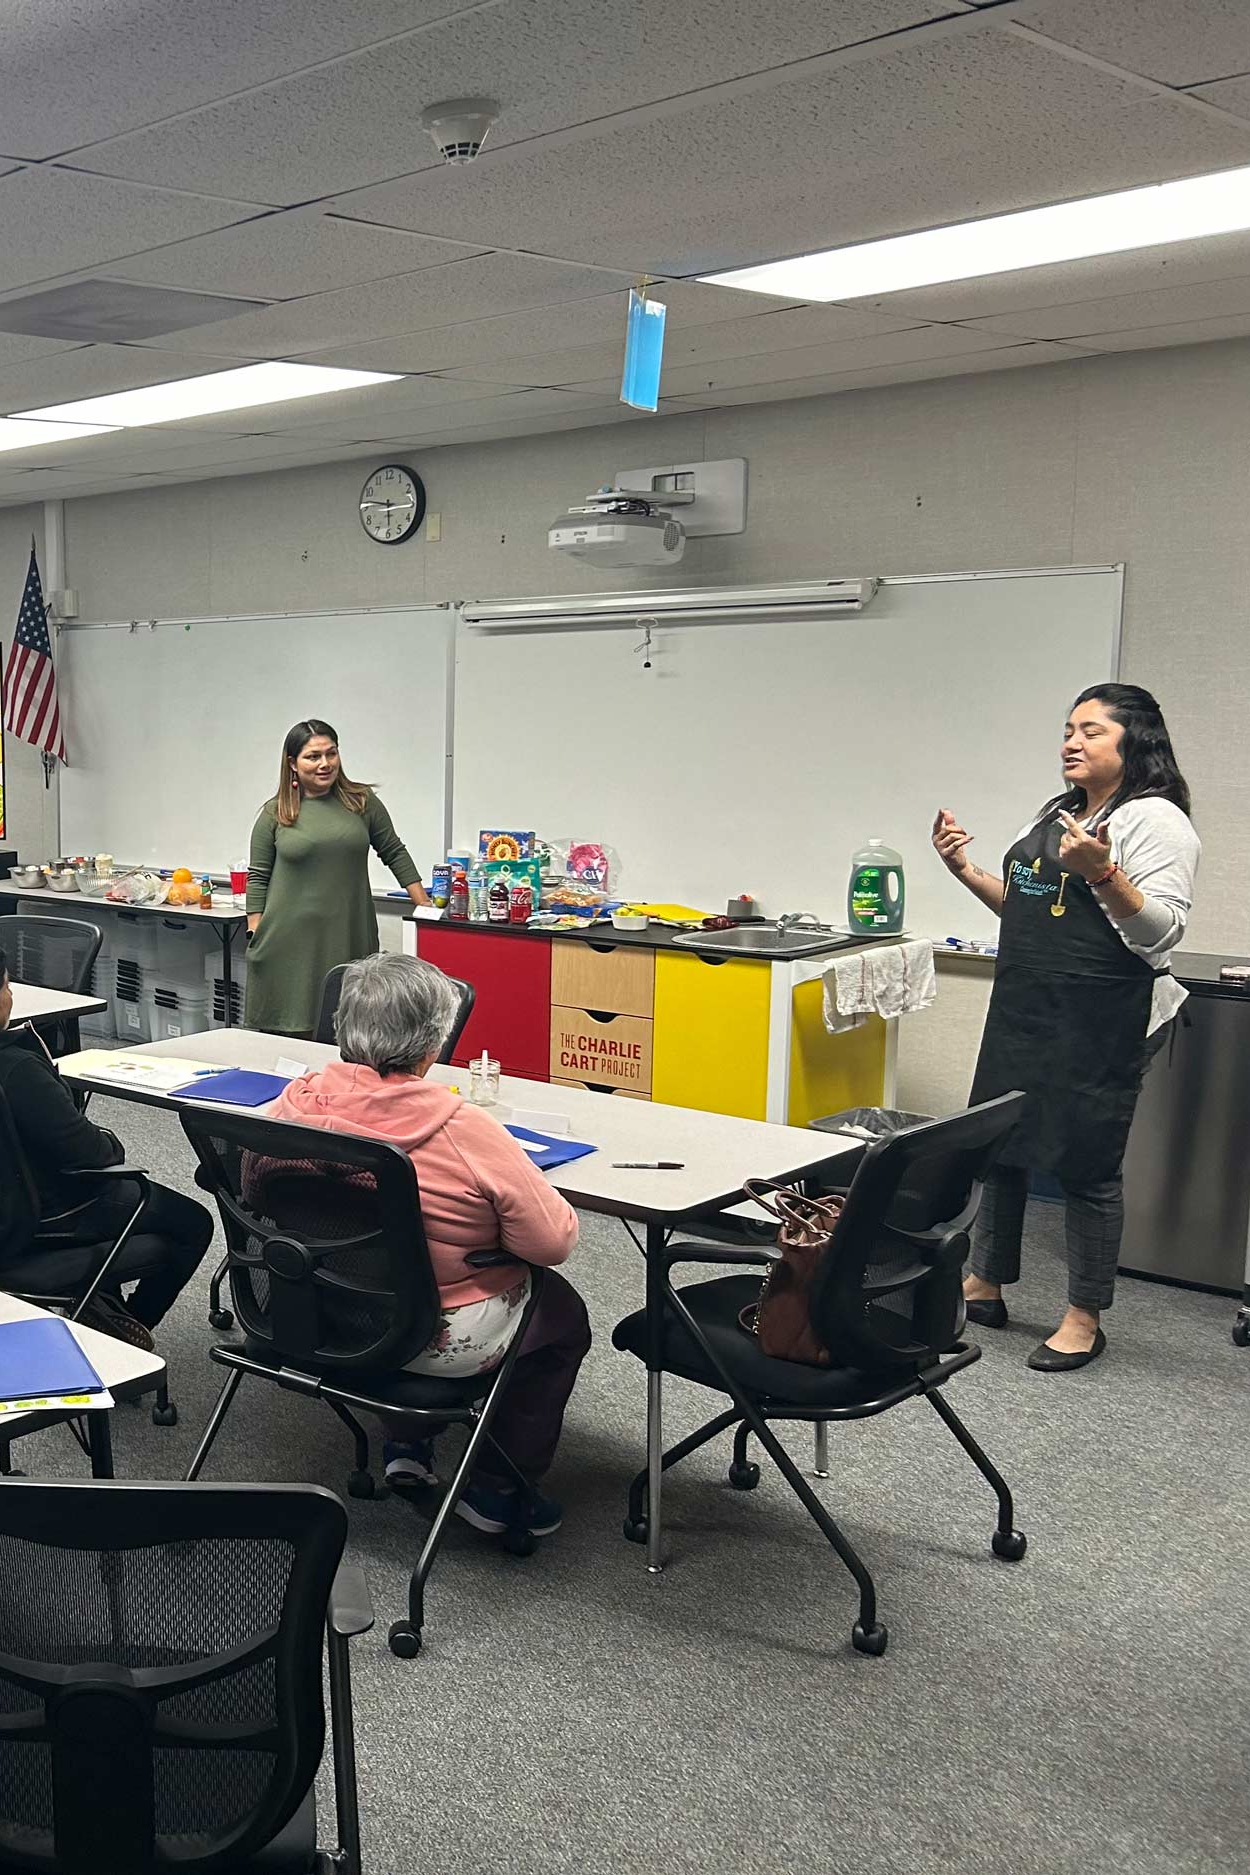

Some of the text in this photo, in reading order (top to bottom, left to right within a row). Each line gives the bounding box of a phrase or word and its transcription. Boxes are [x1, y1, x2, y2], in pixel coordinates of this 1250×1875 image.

[385, 470, 395, 480] 12
[375, 476, 382, 486] 11
[365, 486, 374, 497] 10
[406, 483, 412, 494] 2
[366, 515, 372, 525] 8
[406, 513, 411, 523] 4
[374, 526, 381, 536] 7
[385, 529, 391, 539] 6
[396, 524, 402, 534] 5
[1013, 860, 1023, 874] Yo
[560, 1032, 642, 1060] THE CHARLIE
[560, 1051, 641, 1079] CART PROJECT
